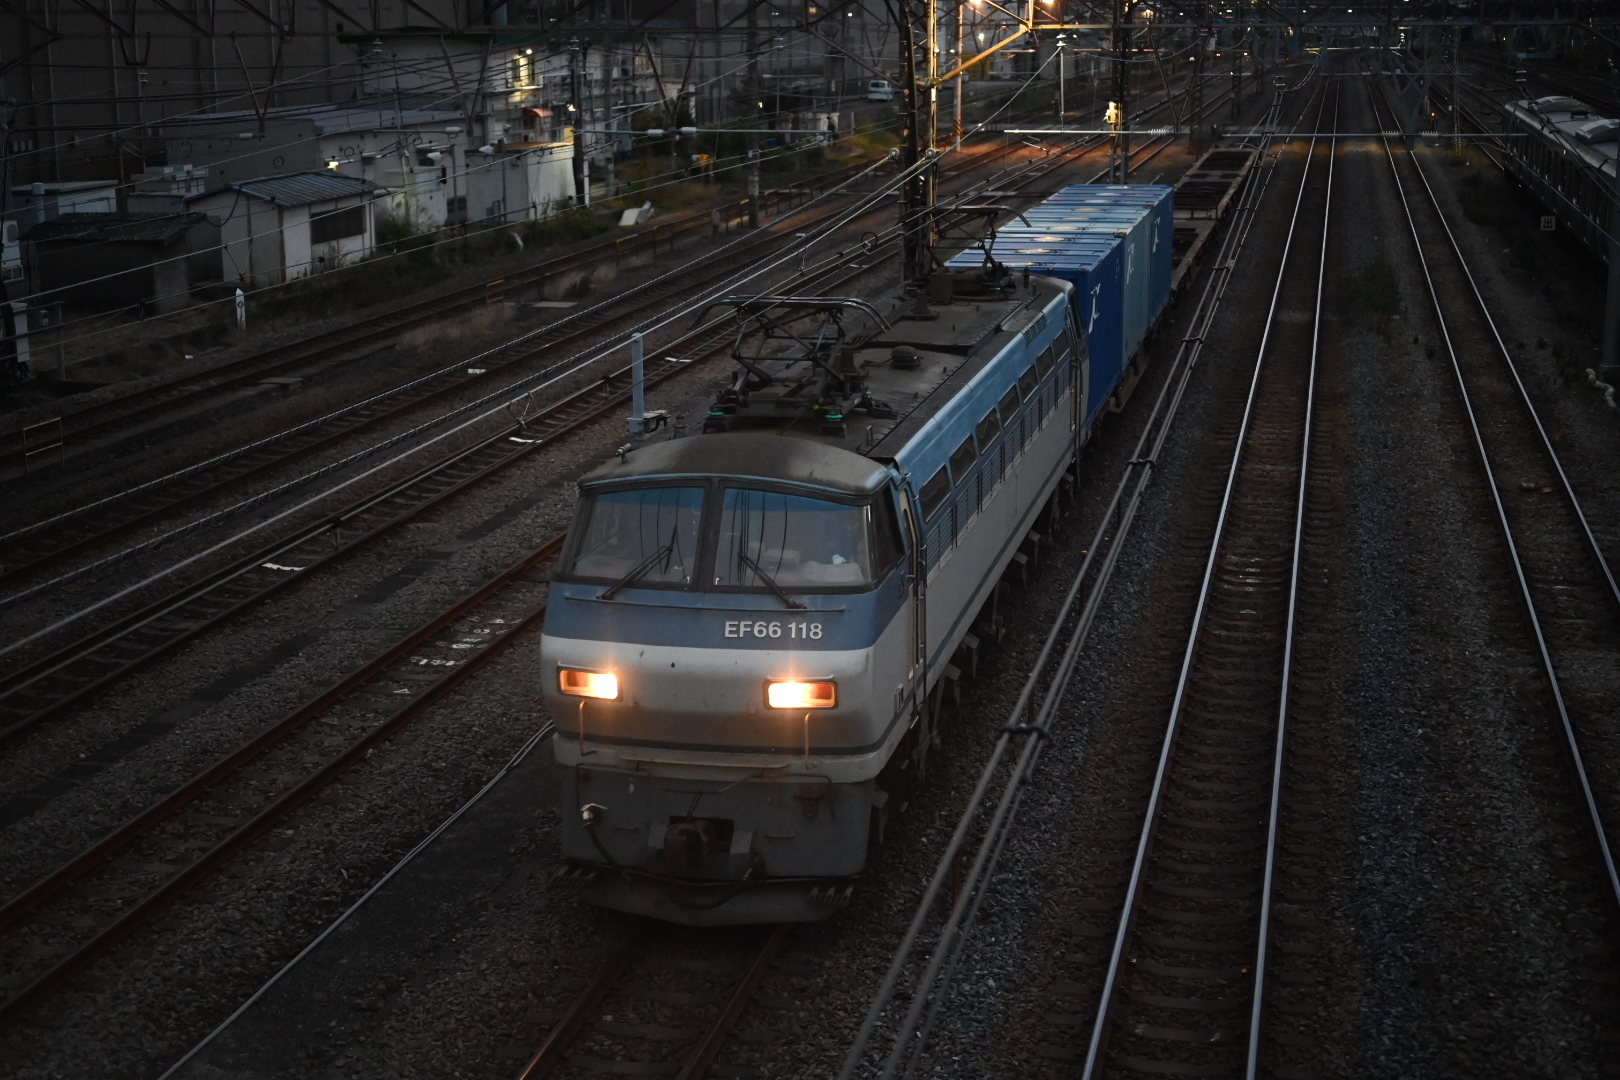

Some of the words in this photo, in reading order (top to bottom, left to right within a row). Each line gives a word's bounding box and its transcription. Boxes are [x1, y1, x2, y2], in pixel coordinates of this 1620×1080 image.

[1543, 217, 1553, 229] 出
[724, 620, 782, 639] EF66
[787, 621, 823, 640] 118
